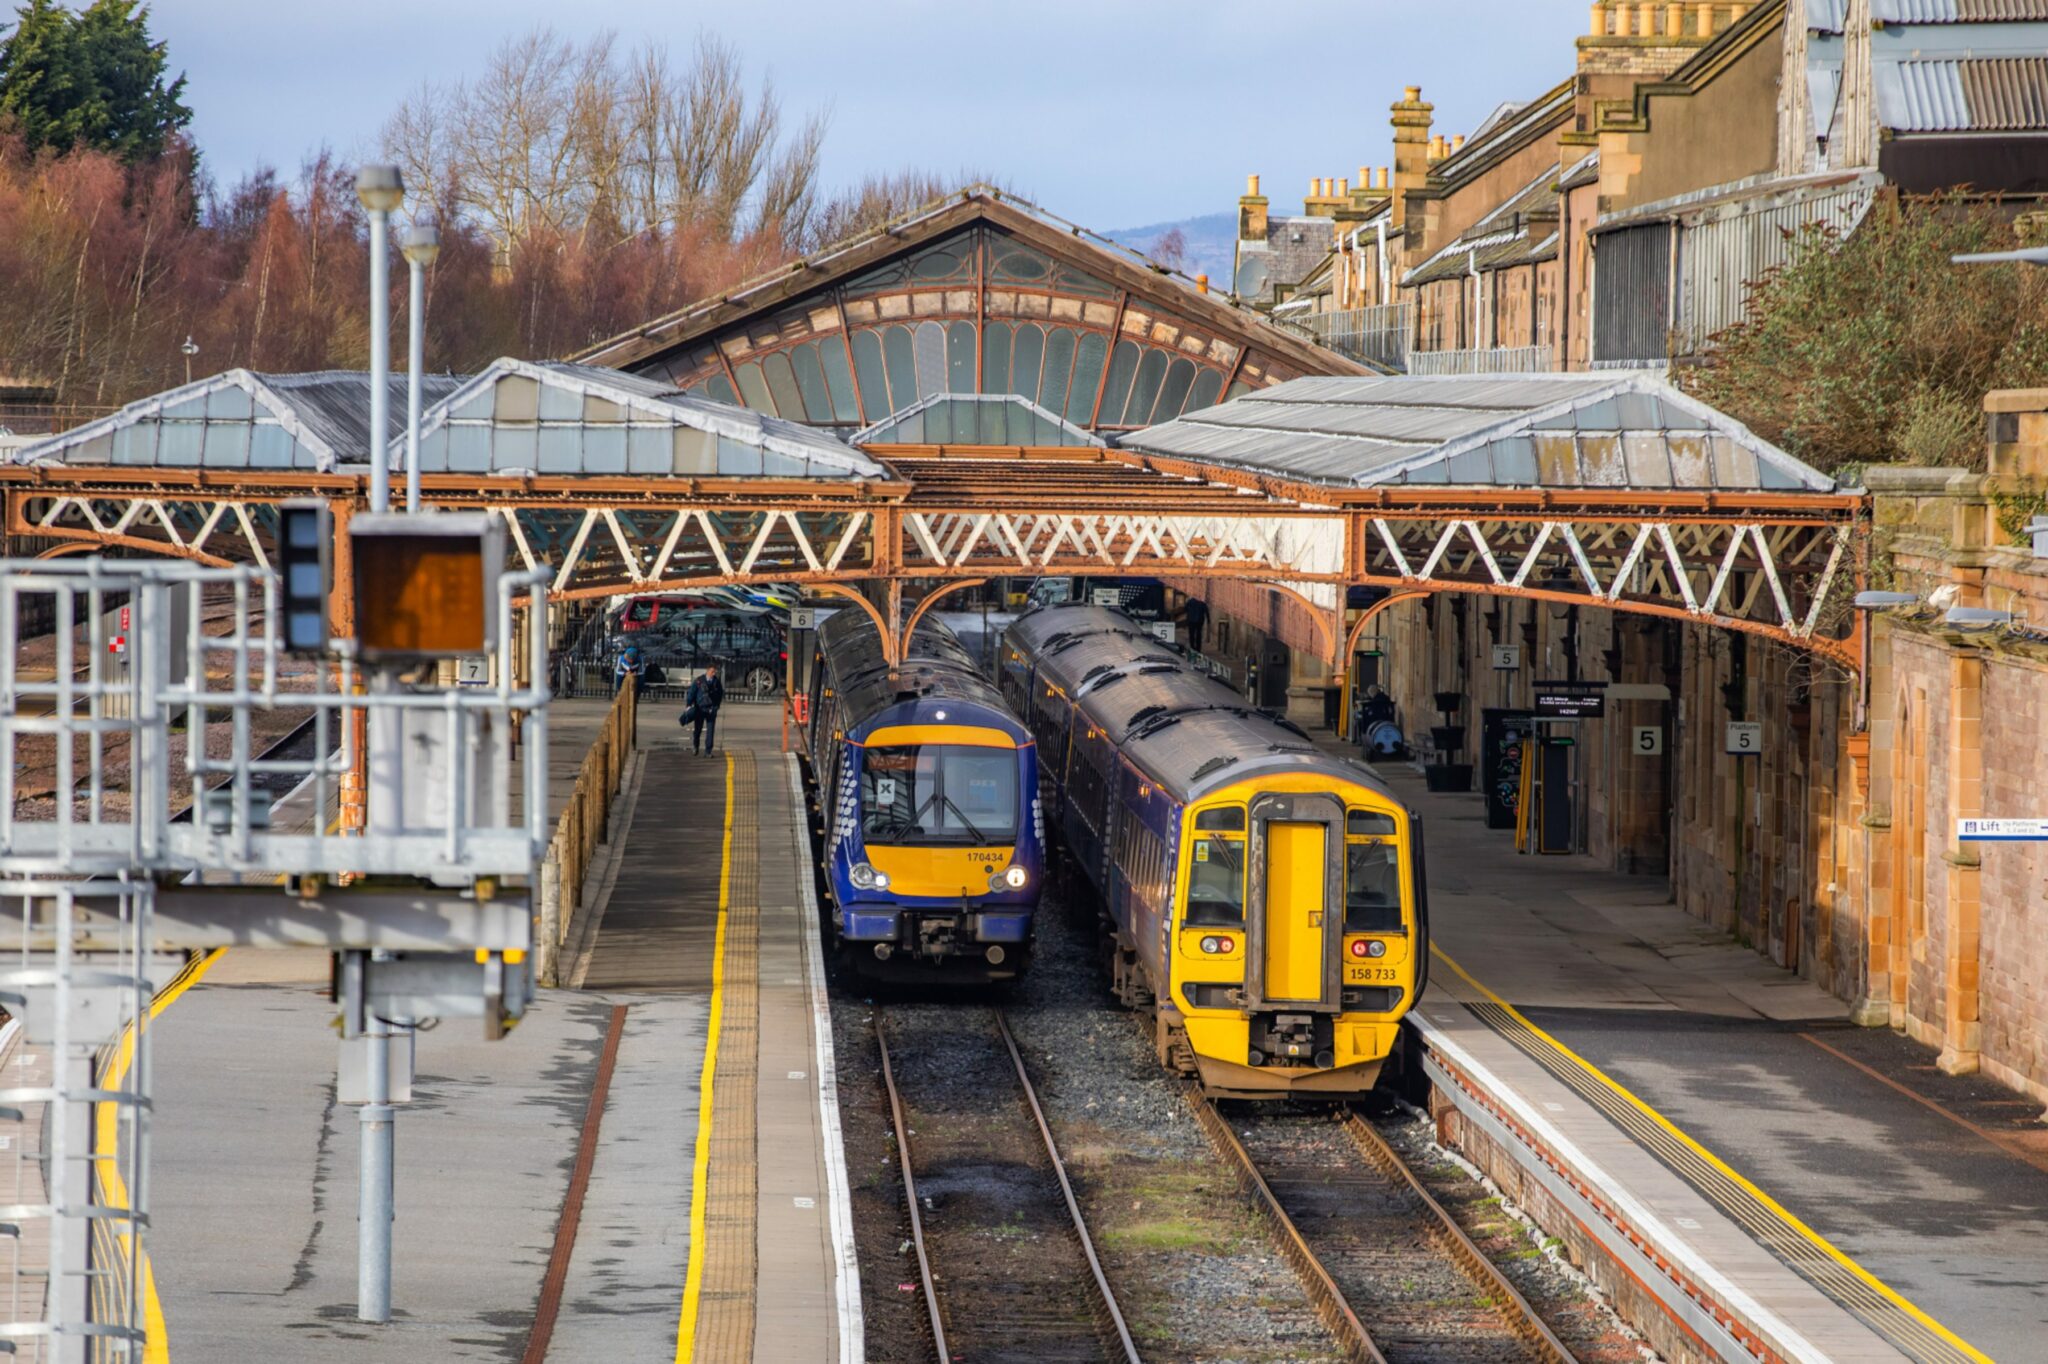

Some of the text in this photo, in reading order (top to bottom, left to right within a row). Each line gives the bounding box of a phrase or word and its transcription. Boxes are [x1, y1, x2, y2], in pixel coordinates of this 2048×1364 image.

[799, 615, 806, 625] 6
[1160, 630, 1168, 639] 5
[1503, 653, 1511, 664] 5
[469, 665, 478, 678] 7
[1640, 731, 1654, 750] 5
[1739, 733, 1750, 748] 5
[880, 784, 892, 794] X
[1981, 821, 2000, 831] Lift
[967, 853, 1003, 862] 170434
[1351, 968, 1396, 980] 158 733
